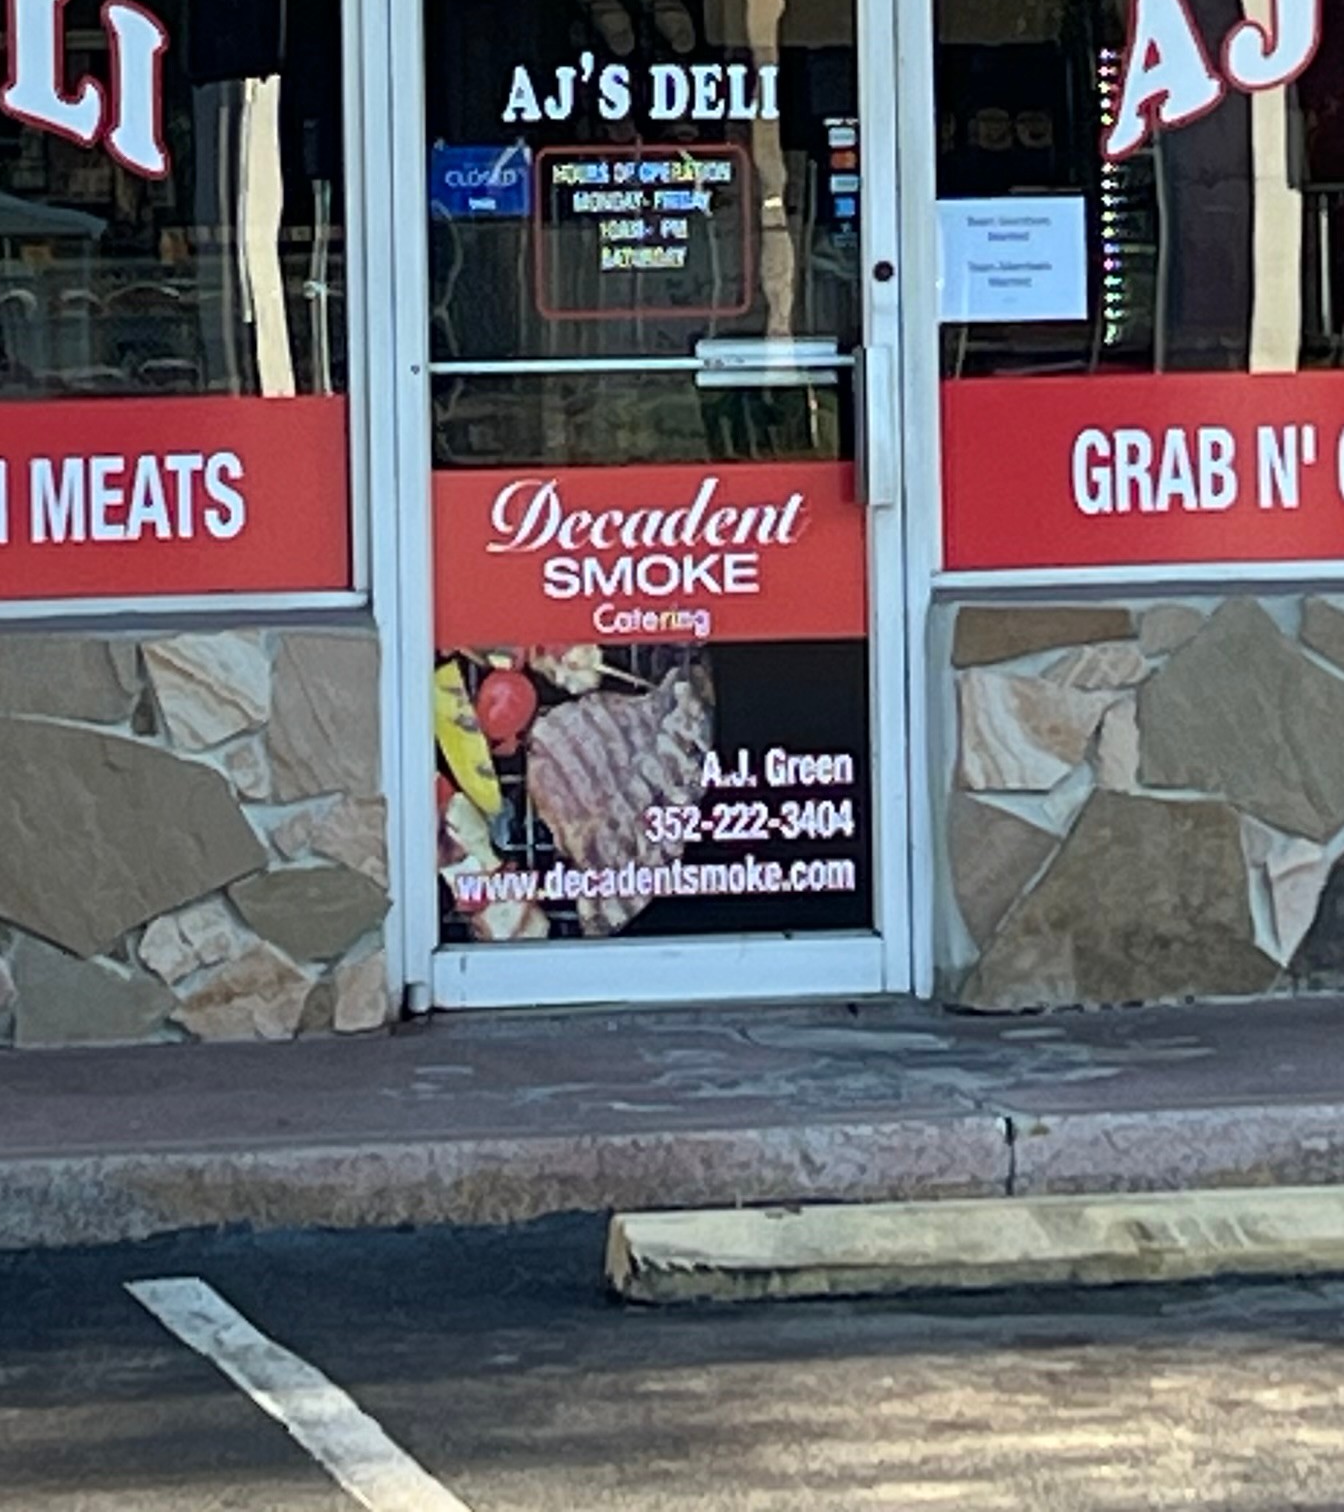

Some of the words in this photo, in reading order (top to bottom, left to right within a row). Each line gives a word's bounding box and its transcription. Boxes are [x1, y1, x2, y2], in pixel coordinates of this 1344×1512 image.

[501, 51, 631, 122] AJ'S
[648, 63, 780, 121] DELI
[1071, 426, 1238, 515] GRAB
[1257, 424, 1317, 509] N'
[30, 452, 245, 545] MEATS
[485, 477, 811, 553] Decadent
[543, 552, 760, 598] SMOKE
[592, 603, 711, 636] Catering
[701, 750, 758, 788] A.J.
[765, 748, 854, 784] Green
[645, 800, 855, 842] 352-222-3404
[454, 854, 855, 901] www.decadentsmoke.com
